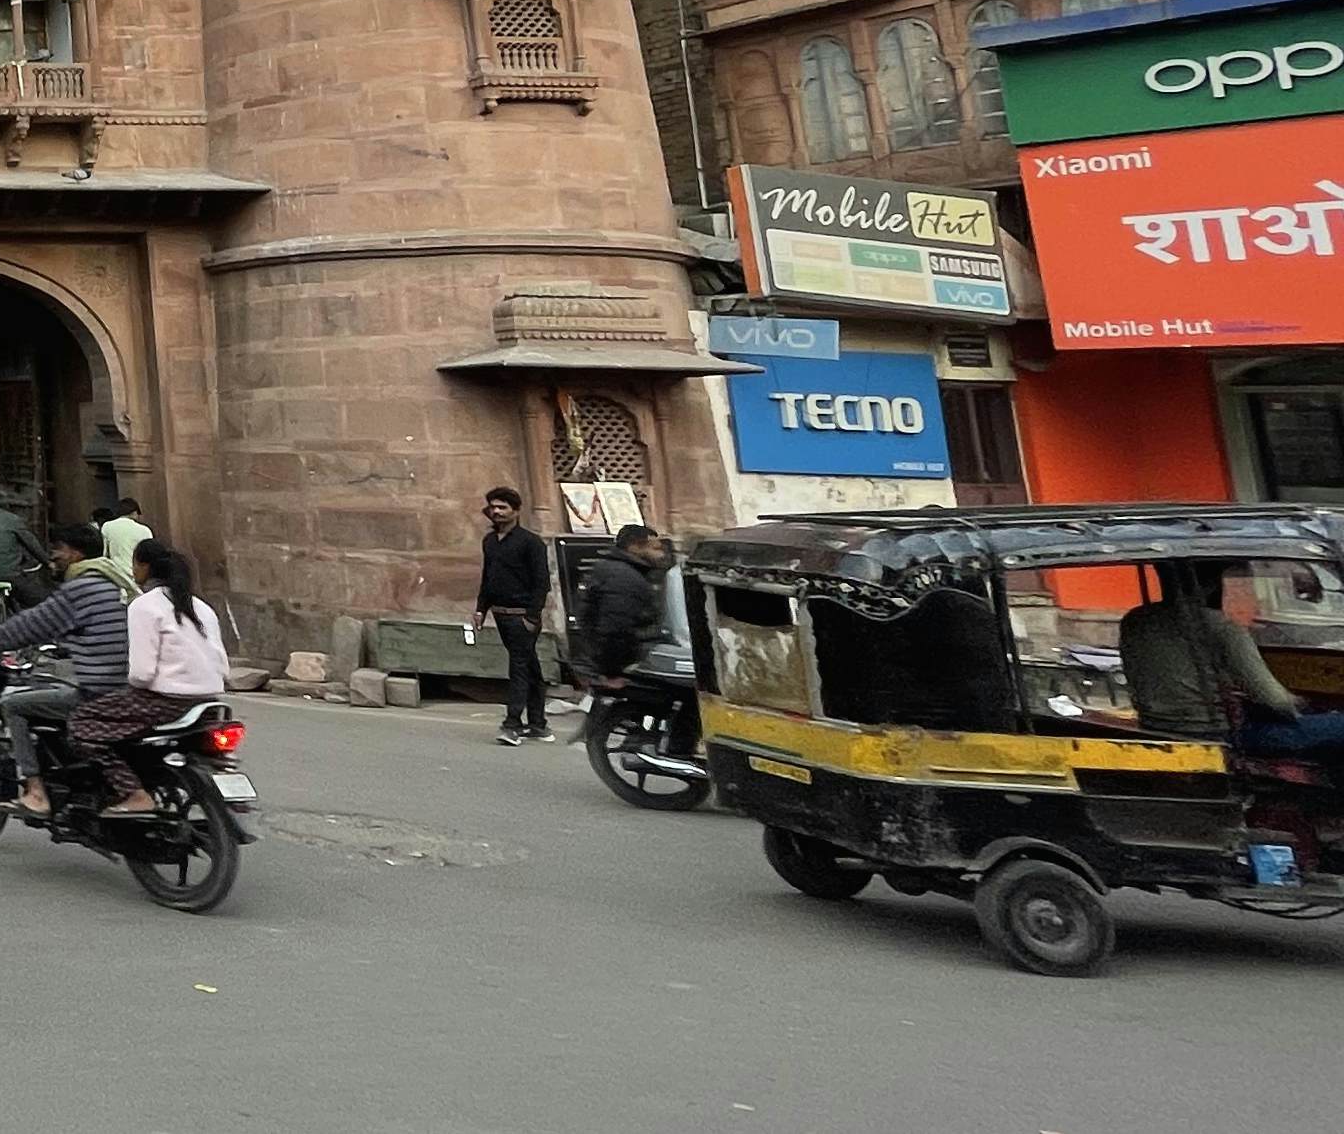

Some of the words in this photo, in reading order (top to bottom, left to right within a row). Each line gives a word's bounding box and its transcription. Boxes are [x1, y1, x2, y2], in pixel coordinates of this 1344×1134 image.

[1143, 41, 1344, 98] opp
[1033, 146, 1152, 178] Xiaomi
[759, 185, 910, 233] Mobile
[912, 199, 986, 238] Hut
[929, 255, 1003, 280] SAMSUNG
[1063, 320, 1154, 339] Mobile
[1160, 318, 1215, 336] Hut
[768, 392, 925, 435] TECNO
